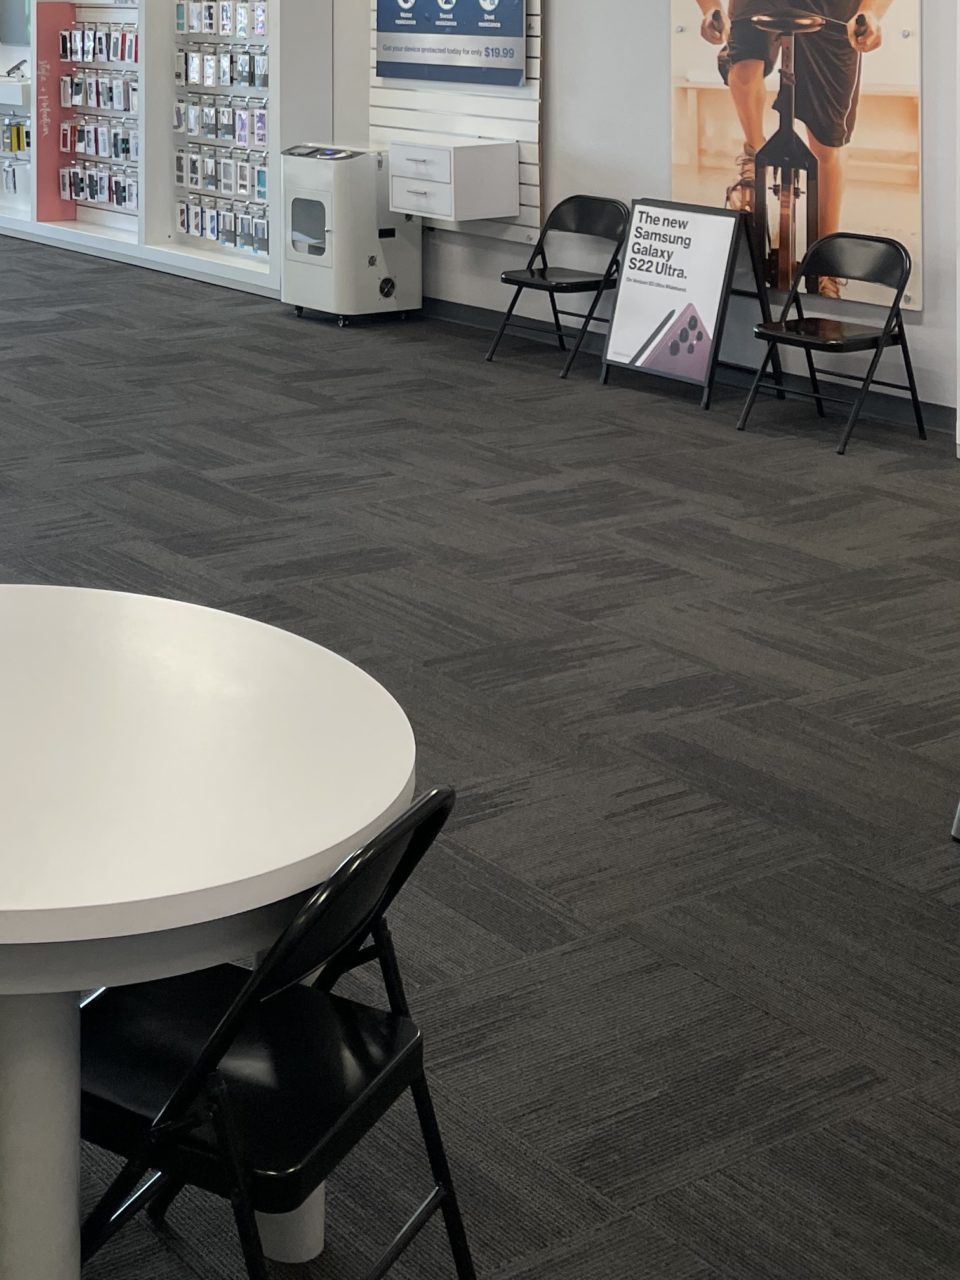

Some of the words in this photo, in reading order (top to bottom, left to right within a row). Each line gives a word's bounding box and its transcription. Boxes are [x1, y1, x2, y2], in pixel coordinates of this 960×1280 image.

[392, 46, 404, 54] your
[470, 48, 482, 57] only
[484, 47, 515, 58] $19.99
[638, 211, 660, 226] The
[662, 217, 689, 230] new
[634, 226, 692, 249] Samsung
[632, 242, 674, 262] Galaxy
[628, 257, 654, 273] S22
[655, 262, 687, 280] Ultra.
